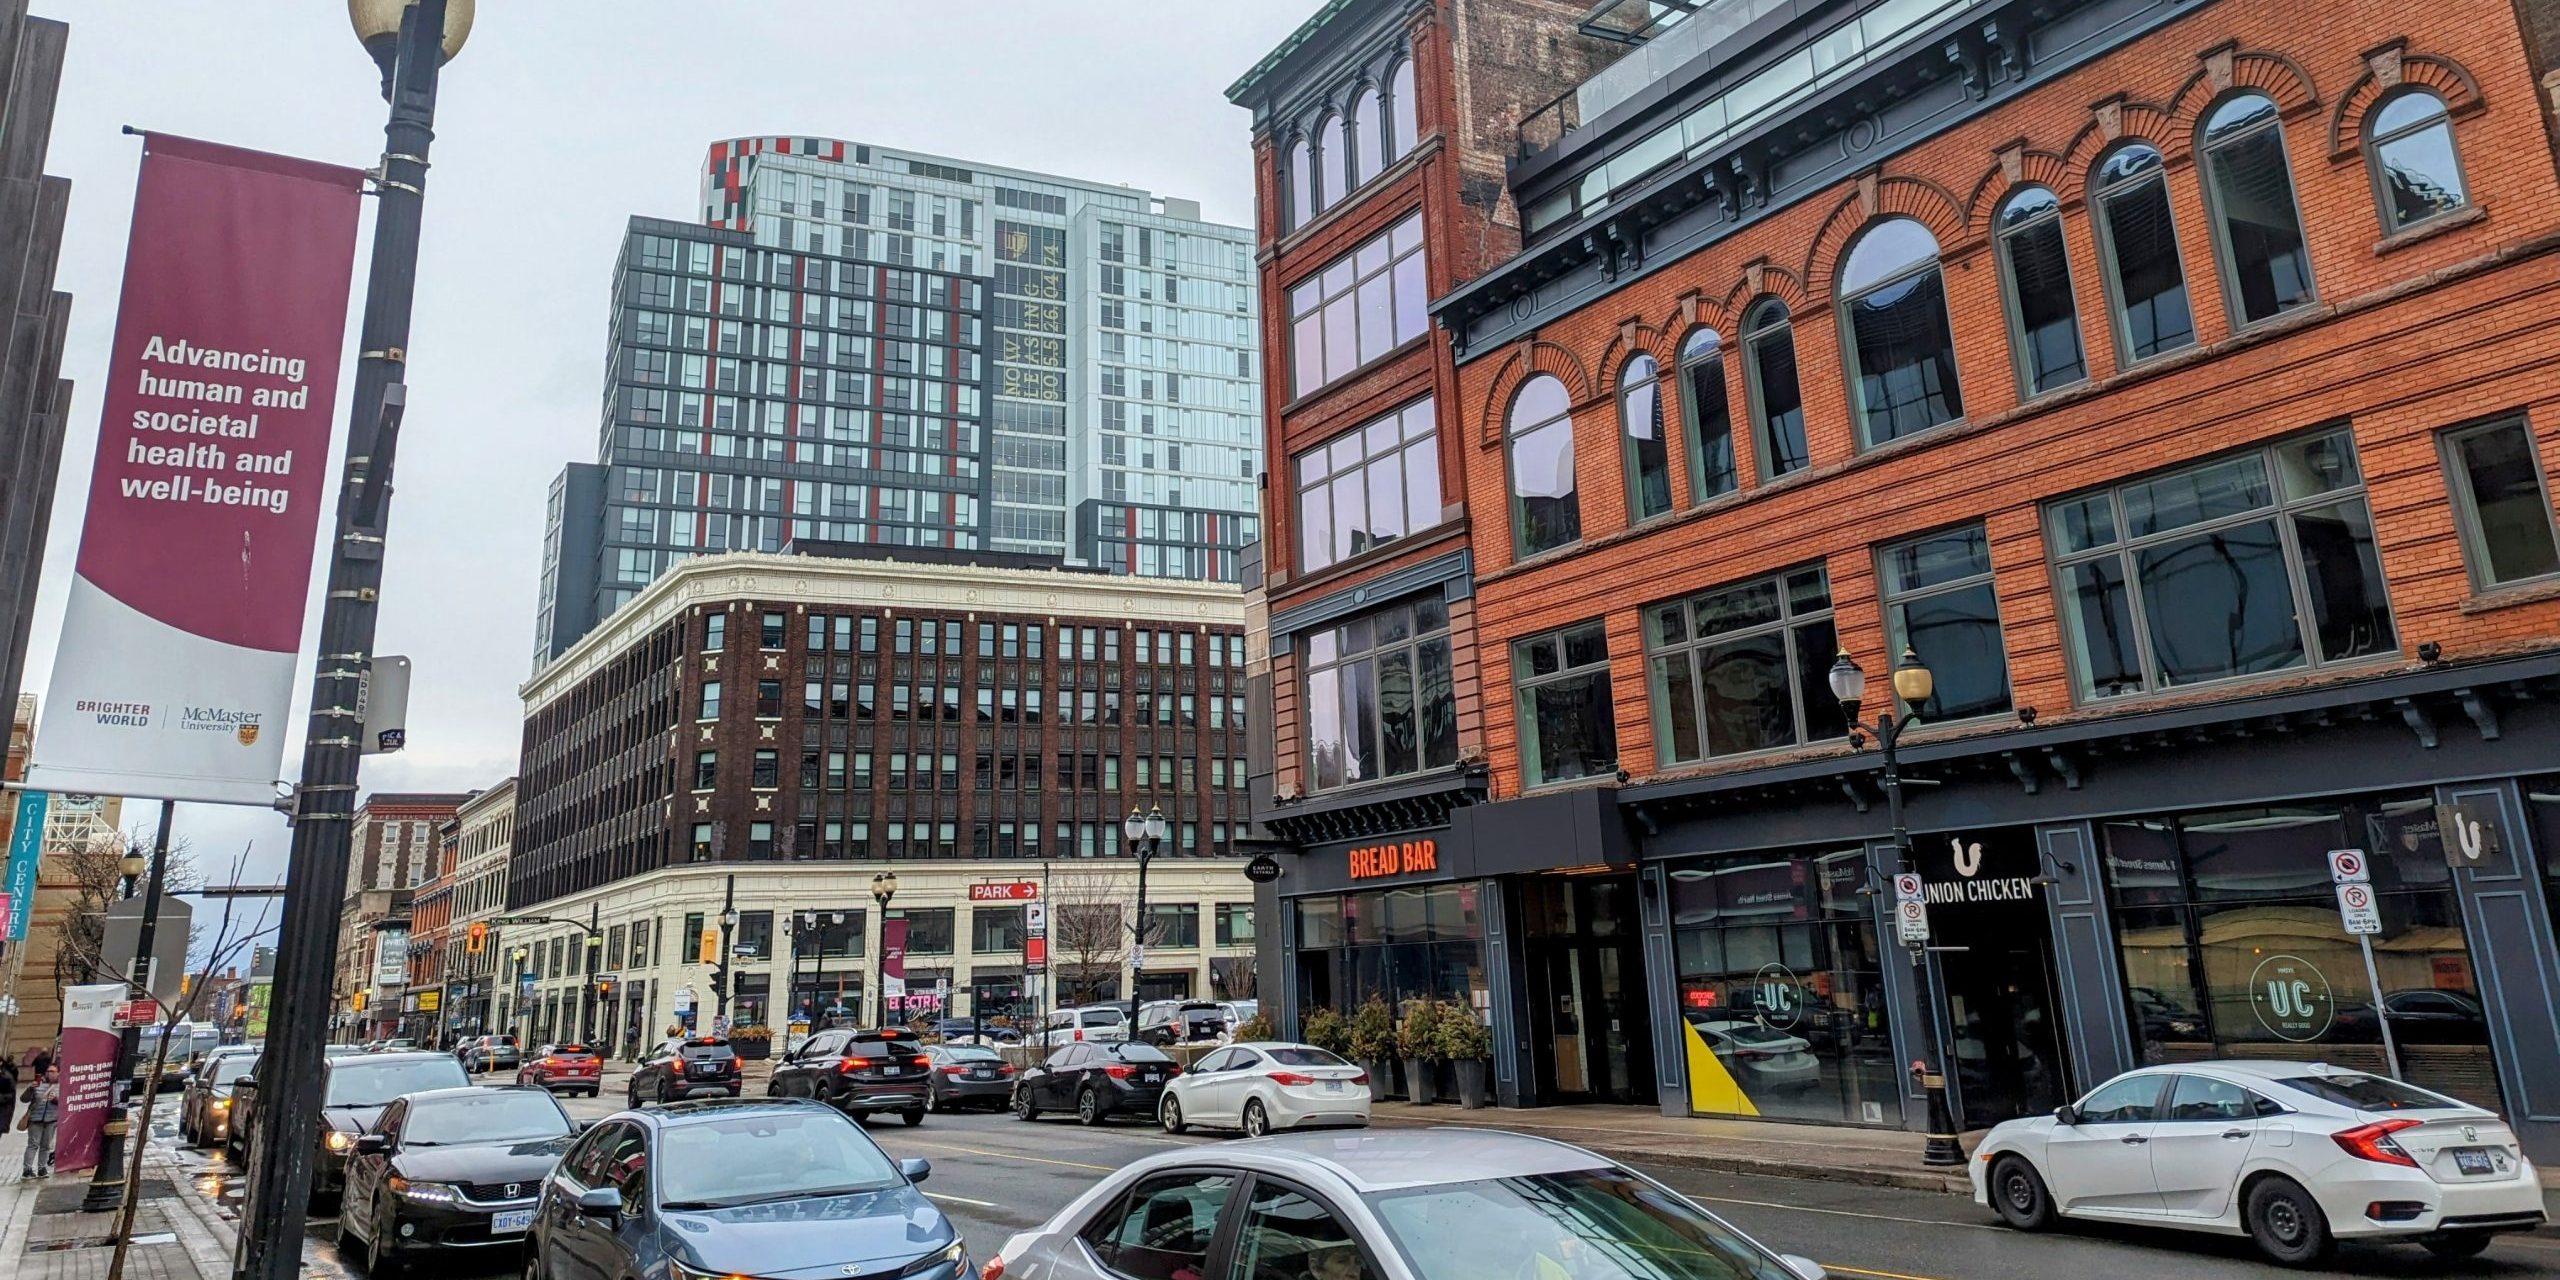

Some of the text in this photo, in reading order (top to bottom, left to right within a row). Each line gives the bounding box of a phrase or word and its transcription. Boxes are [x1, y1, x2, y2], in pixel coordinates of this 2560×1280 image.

[141, 335, 306, 383] Advancing
[1023, 283, 1040, 399] LEASING
[1005, 338, 1021, 397] NOW
[138, 369, 309, 410] human and
[132, 408, 258, 439] societal
[127, 437, 293, 475] health and
[121, 475, 289, 514] well-being
[76, 701, 150, 716] BRIGHTER
[96, 713, 148, 727] WORLD
[181, 706, 262, 724] McMaster
[181, 720, 237, 734] University
[21, 803, 38, 853] CITY
[1350, 840, 1436, 878] BREAD BAR
[6, 860, 27, 938] CENTRE
[974, 885, 1012, 898] PARK
[1967, 877, 2033, 902] CHICKEN
[1764, 982, 1791, 1011] UC
[2267, 980, 2314, 1018] UC
